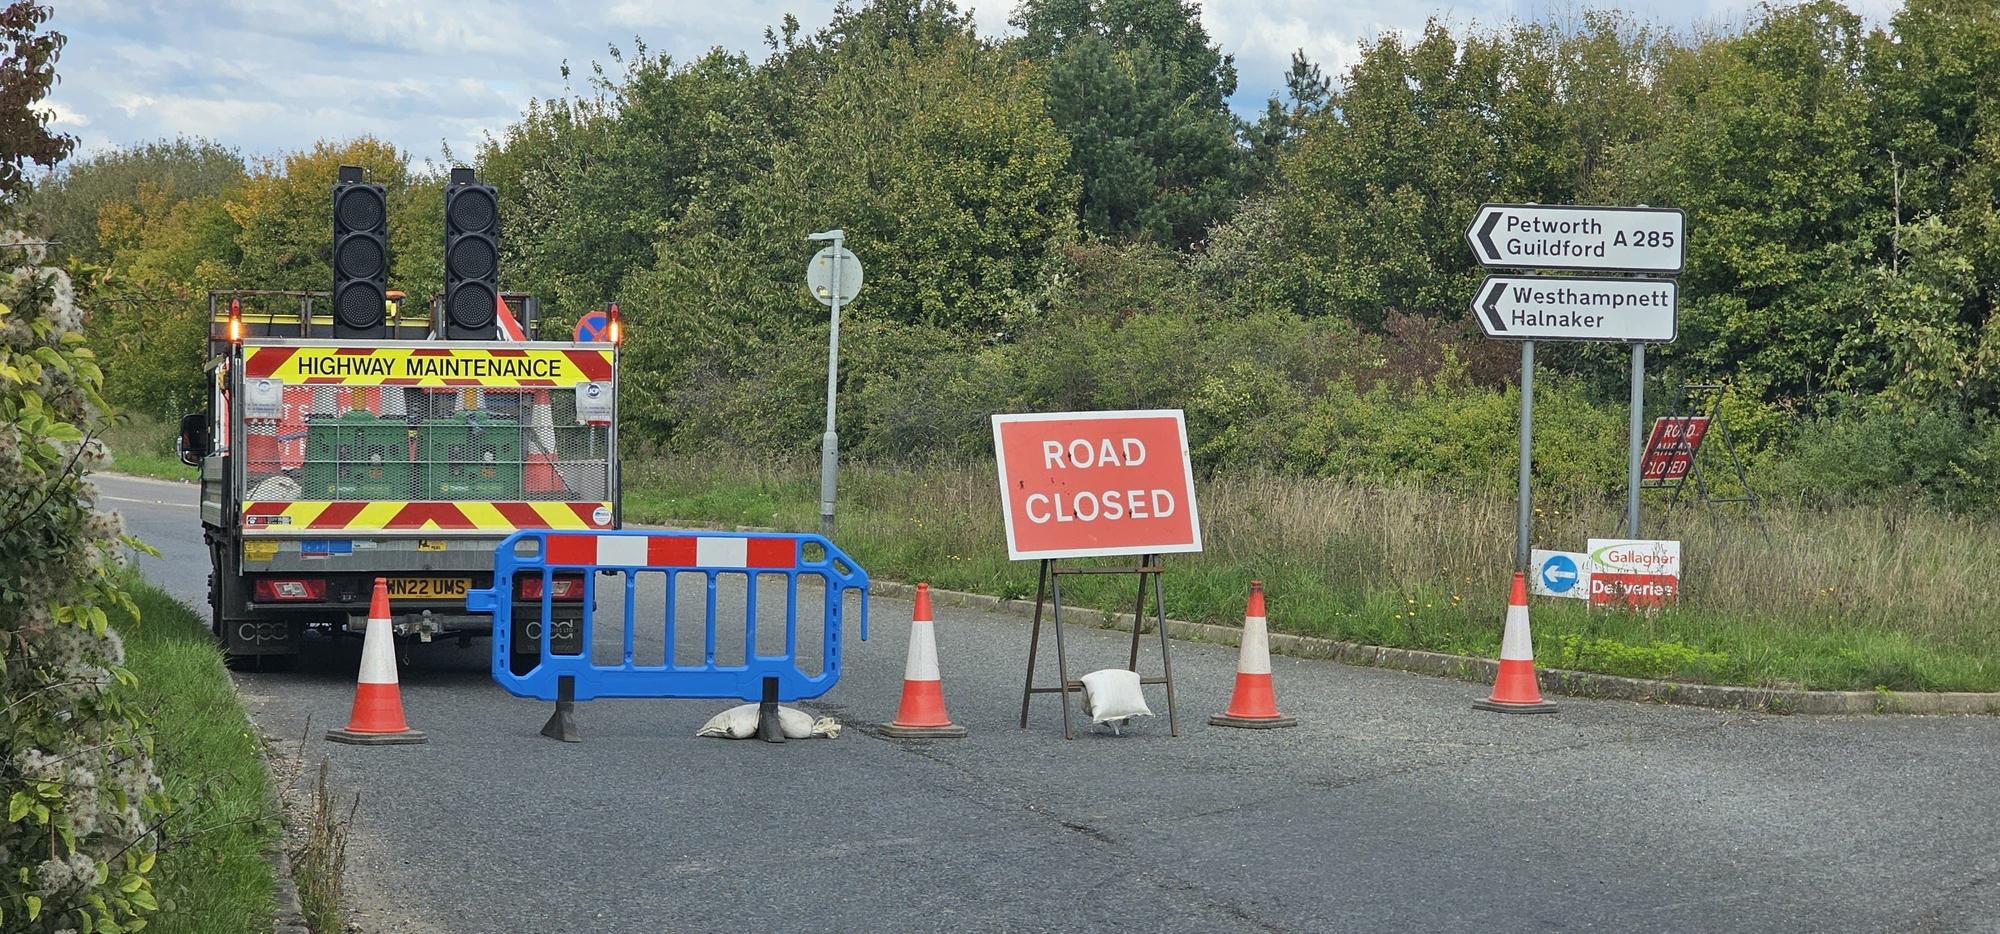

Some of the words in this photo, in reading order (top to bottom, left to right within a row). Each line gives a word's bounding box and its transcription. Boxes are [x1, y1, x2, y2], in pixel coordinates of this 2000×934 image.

[1507, 215, 1601, 235] Petworth
[1507, 238, 1605, 258] Guildford
[1613, 230, 1628, 247] A
[1632, 230, 1674, 248] 285
[1513, 287, 1669, 309] Westhampnett
[1511, 309, 1604, 328] Halnaker
[298, 356, 396, 376] HIGHWAY
[406, 358, 561, 377] MAINTENANCE
[1663, 424, 1696, 438] ROD
[1042, 437, 1146, 470] ROAD
[1025, 488, 1176, 524] CLOSED
[1608, 550, 1675, 567] Gallagher
[386, 579, 429, 595] WN22
[433, 579, 466, 595] UMS
